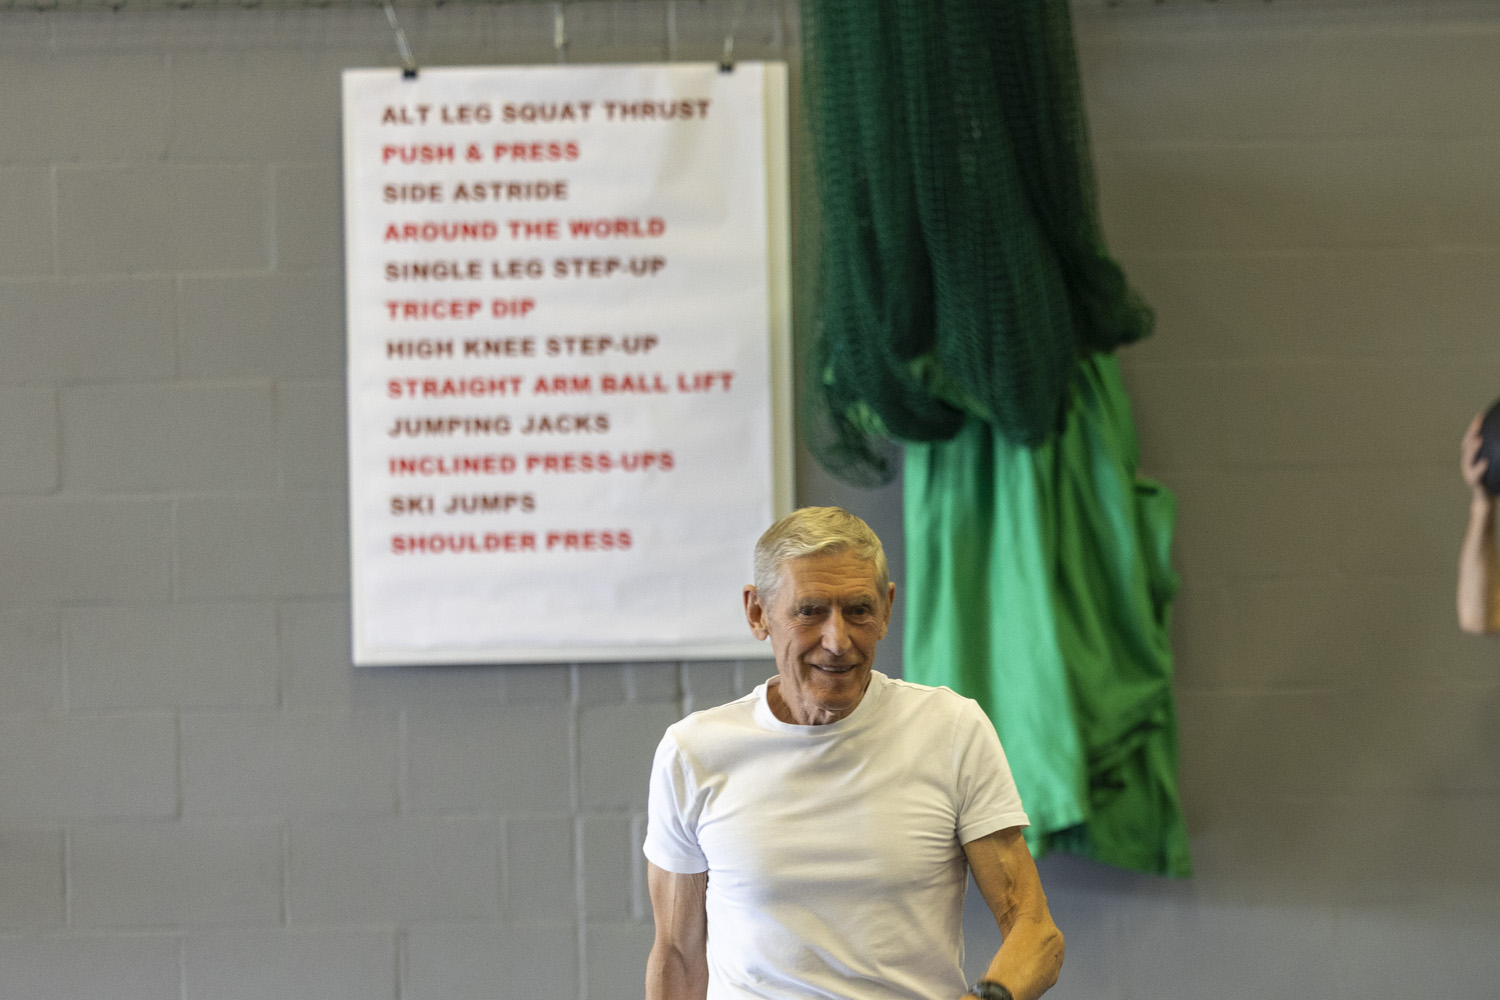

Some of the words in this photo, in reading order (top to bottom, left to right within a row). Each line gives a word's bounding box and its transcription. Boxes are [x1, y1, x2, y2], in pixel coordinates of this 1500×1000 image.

[382, 104, 430, 124] ALT
[441, 103, 493, 123] LEG
[502, 100, 593, 122] SQUAT
[603, 98, 711, 121] THRUST
[381, 143, 456, 163] PUSH
[465, 143, 484, 162] &
[492, 140, 580, 162] PRESS
[383, 182, 443, 202] SIDE
[453, 180, 568, 202] ASTRIDE
[384, 220, 499, 242] AROUND
[508, 219, 560, 239] THE
[568, 216, 667, 239] WORLD
[385, 259, 482, 282] SINGLE
[492, 257, 544, 278] LEG
[552, 255, 667, 278] STEP-UP
[385, 298, 483, 320] TRICEP
[492, 297, 536, 319] DIP
[386, 338, 454, 359] HIGH
[463, 336, 536, 357] KNEE
[545, 333, 659, 356] STEP-UP
[386, 375, 524, 398] STRAIGHT
[533, 375, 593, 395] ARM
[600, 373, 668, 395] BALL
[676, 371, 735, 393] LIFT
[388, 414, 512, 437] JUMPING
[521, 413, 610, 435] JACKS
[388, 453, 518, 476] INCLINED
[525, 450, 675, 473] PRESS-UPS
[389, 495, 435, 516] SKI
[445, 493, 536, 515] JUMPS
[390, 531, 537, 555] SHOULDER
[545, 529, 633, 551] PRESS
